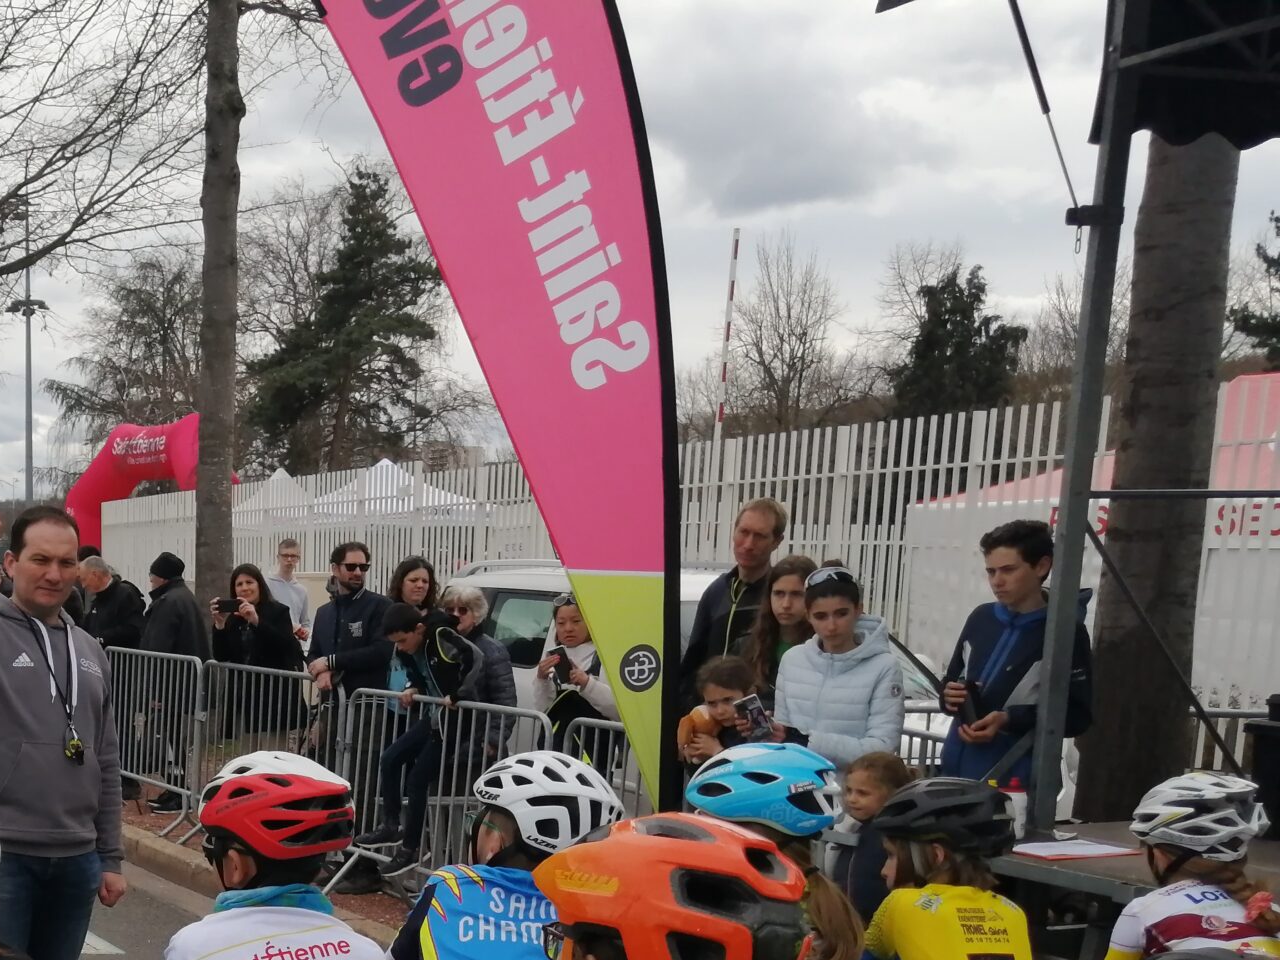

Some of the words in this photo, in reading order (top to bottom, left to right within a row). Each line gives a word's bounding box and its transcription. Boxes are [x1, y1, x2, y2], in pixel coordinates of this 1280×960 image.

[476, 786, 501, 802] LAZER
[526, 834, 558, 851] LAZER
[489, 887, 556, 919] SAIN
